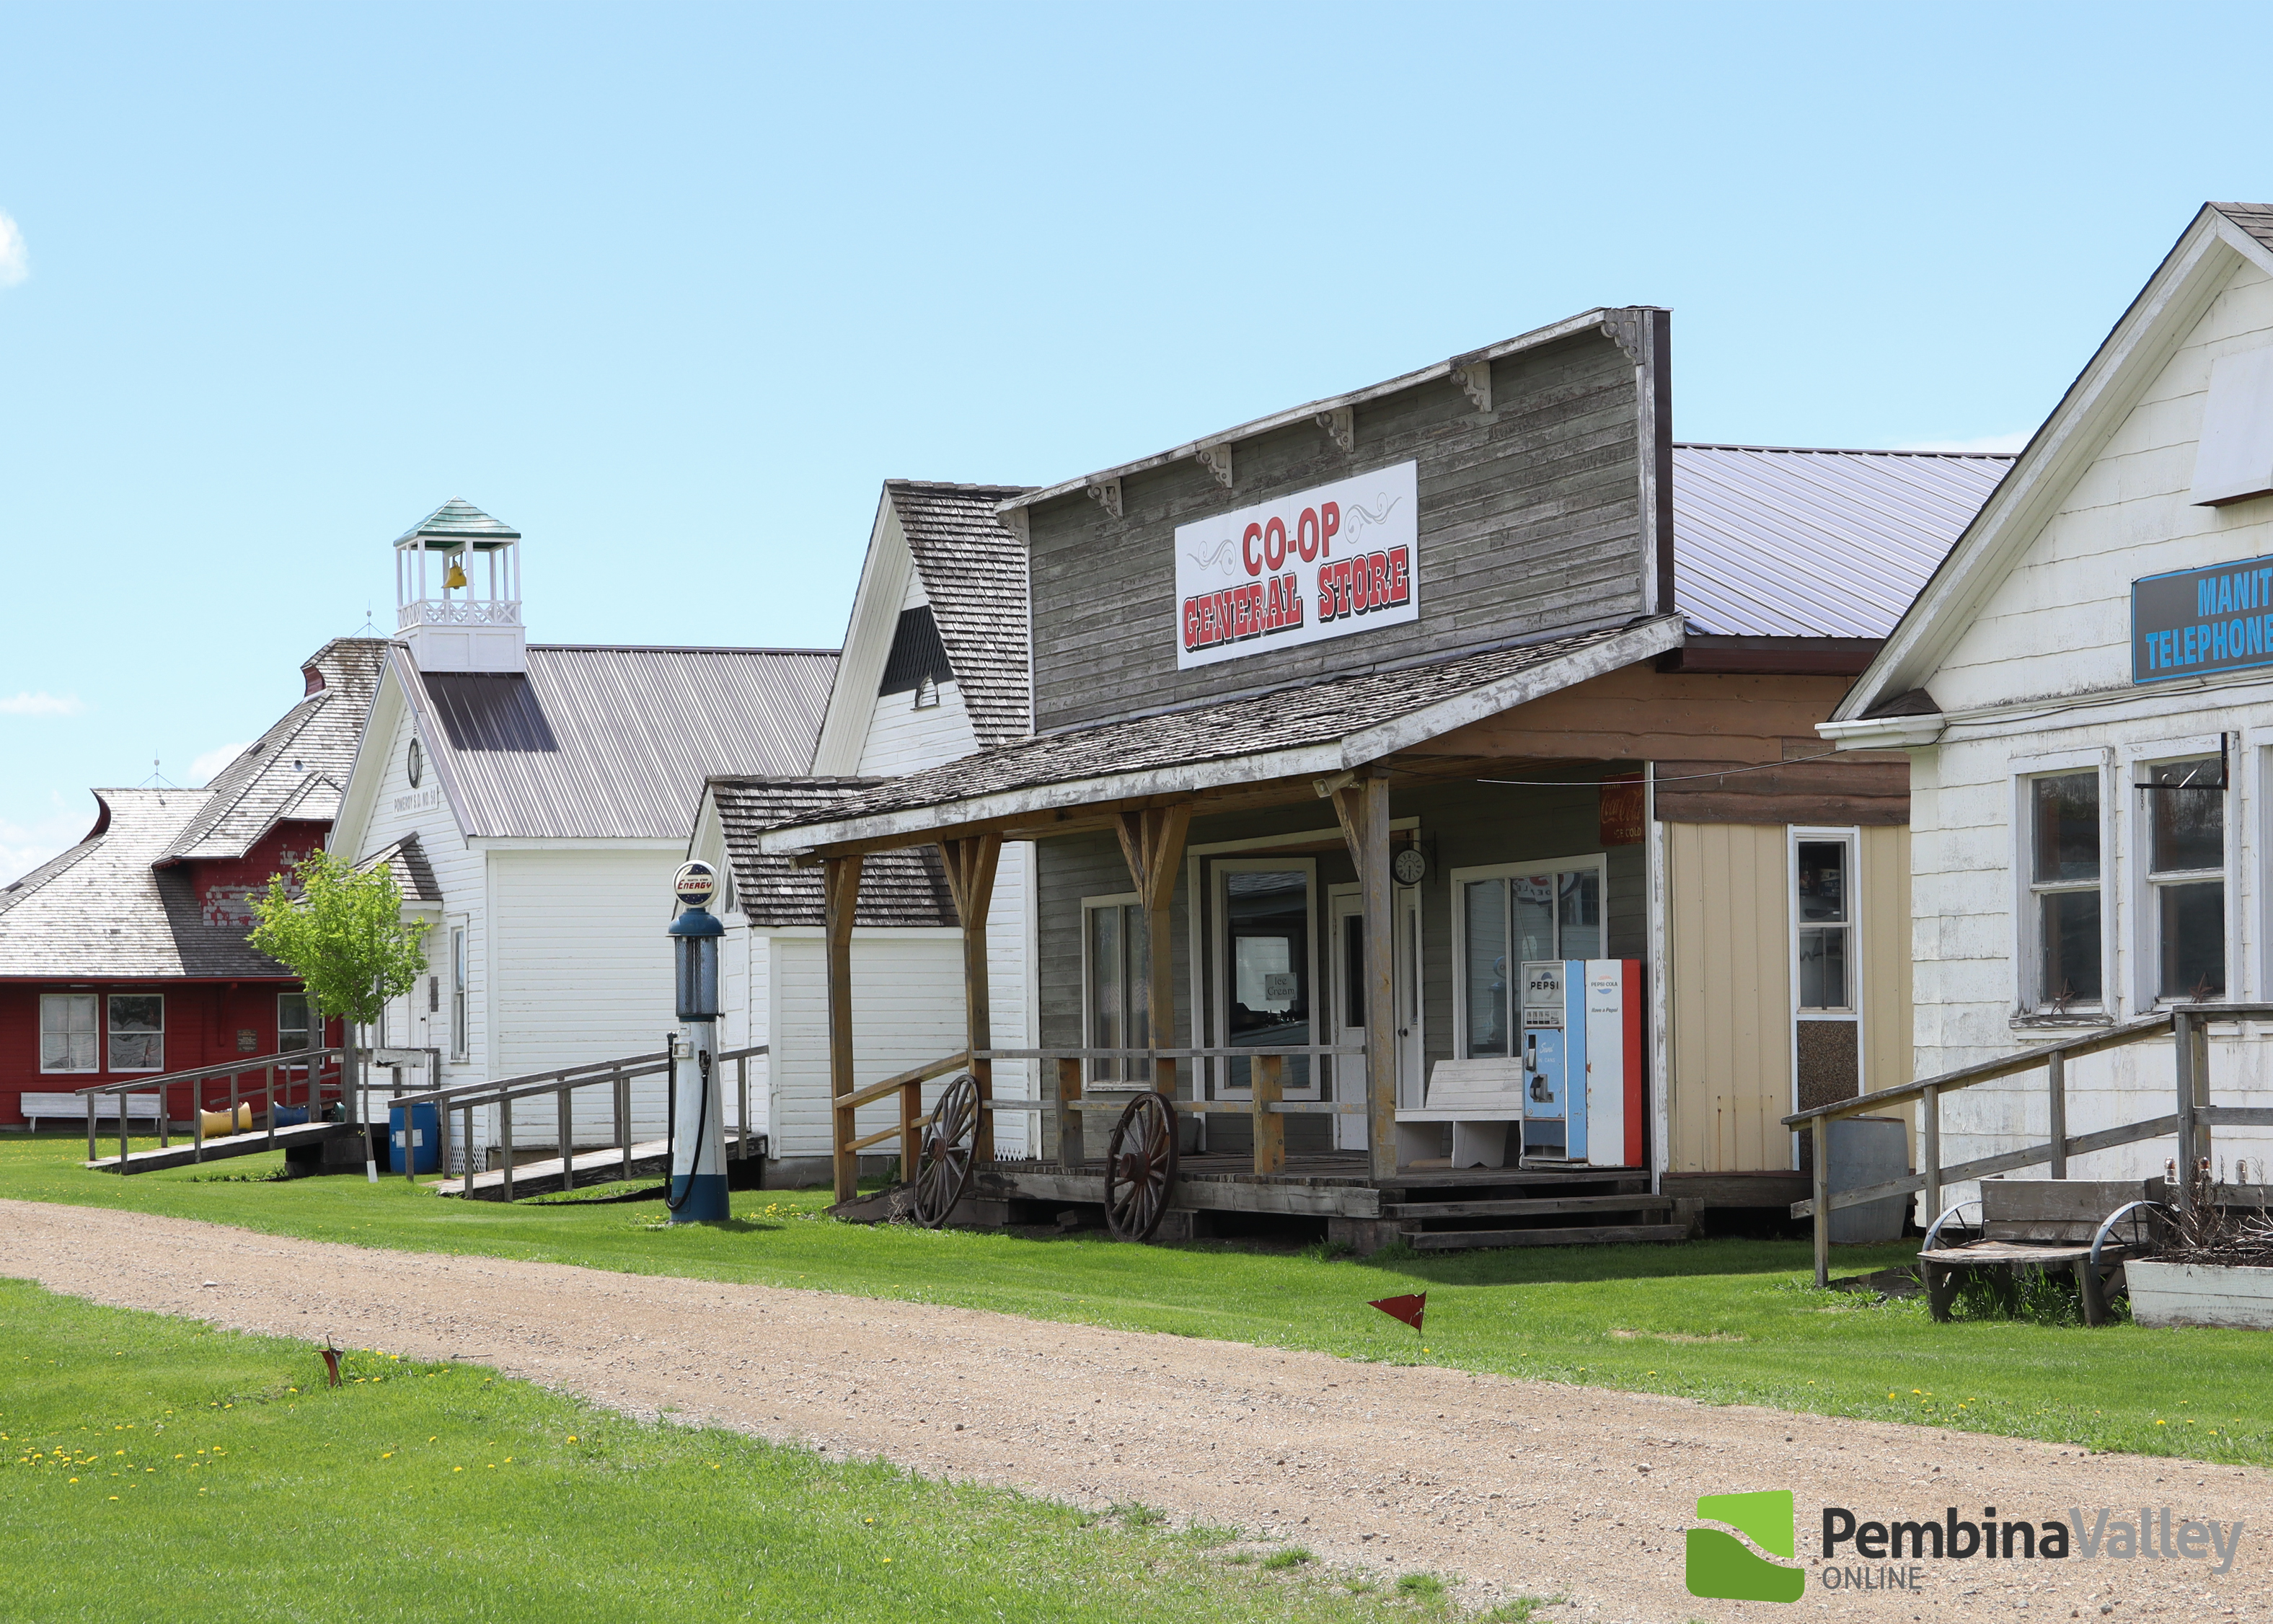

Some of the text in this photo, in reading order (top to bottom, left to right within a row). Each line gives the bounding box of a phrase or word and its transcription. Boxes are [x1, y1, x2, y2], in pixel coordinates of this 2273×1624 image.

[1243, 501, 1340, 576] CO-OP
[1183, 544, 1411, 653] GENERAL STORE
[2197, 567, 2273, 617] MANIT
[2145, 613, 2273, 670] TELEPHONE
[394, 795, 413, 813] POMEROY
[1625, 827, 1641, 837] COLD
[1274, 976, 1287, 986] Ice
[1530, 981, 1559, 990] PEPSI
[1267, 987, 1295, 996] Cream
